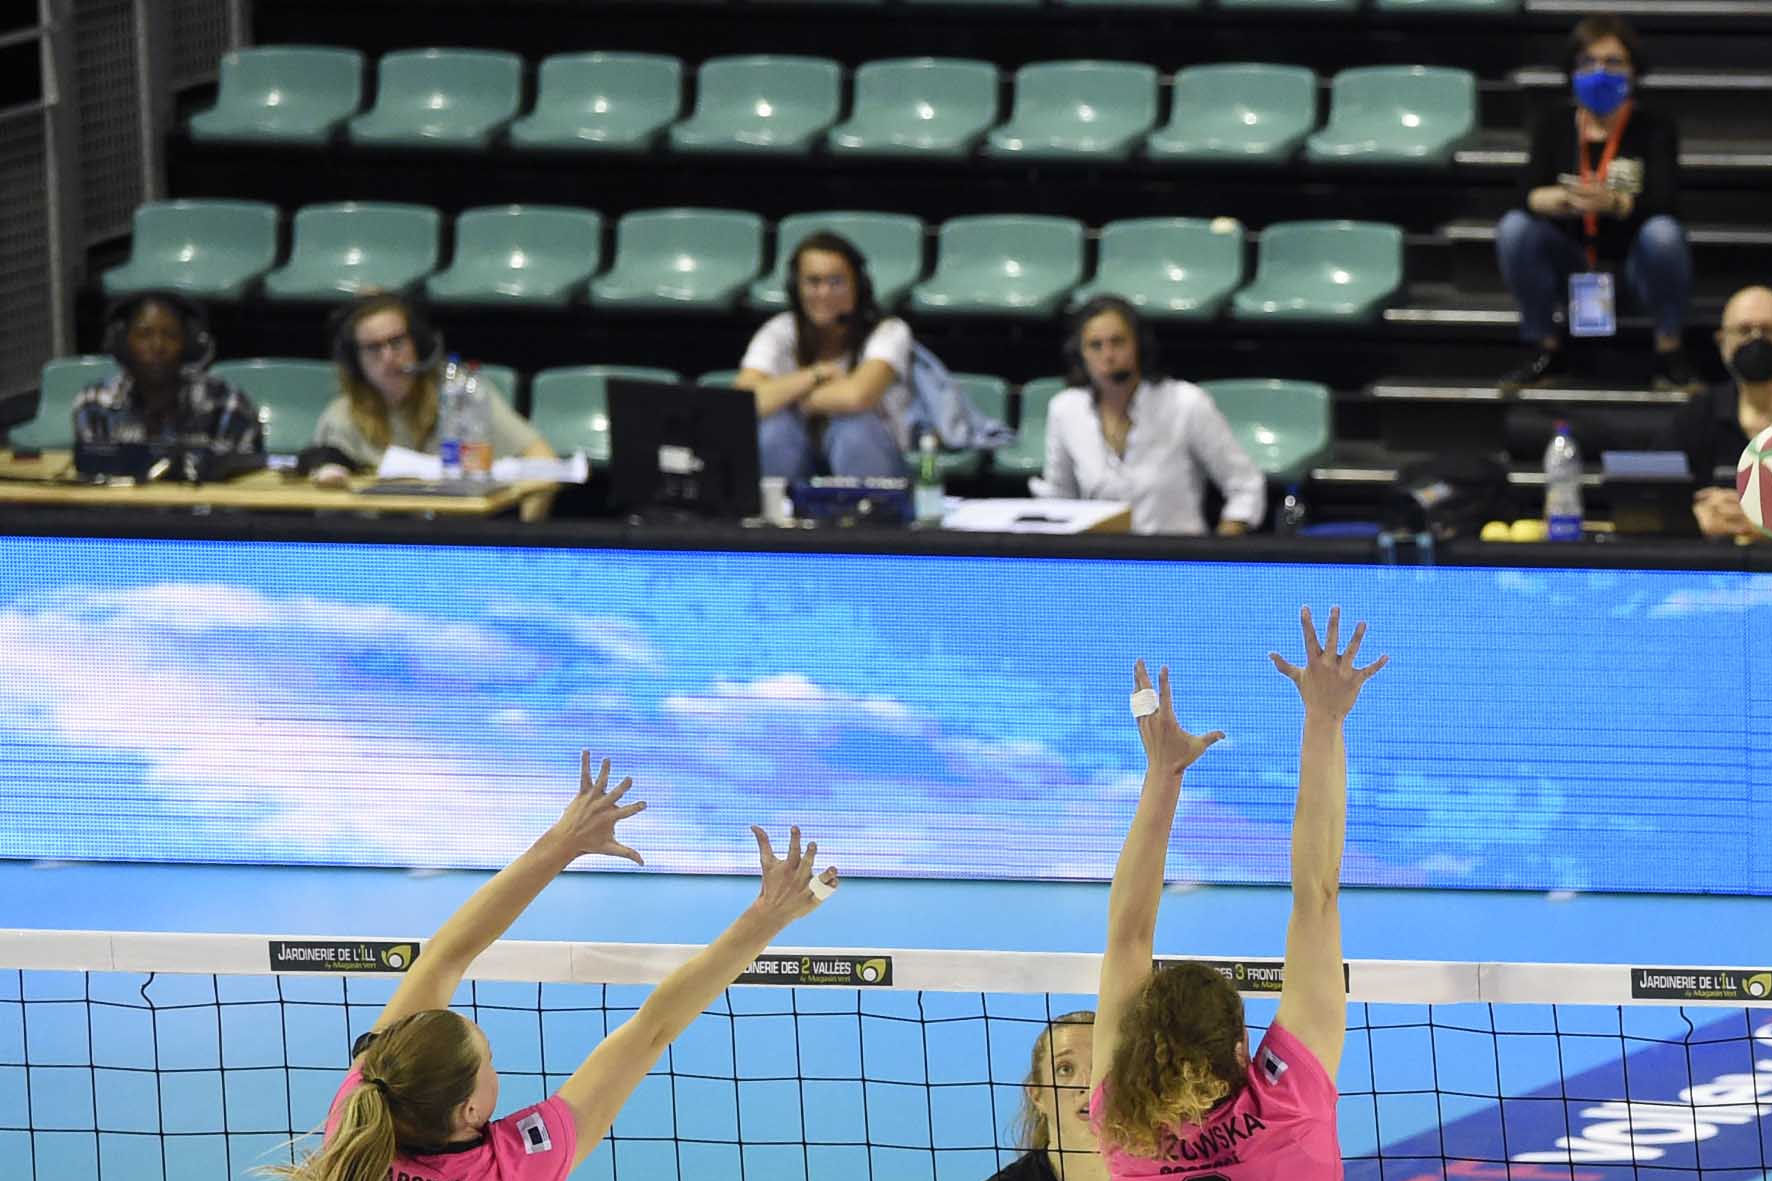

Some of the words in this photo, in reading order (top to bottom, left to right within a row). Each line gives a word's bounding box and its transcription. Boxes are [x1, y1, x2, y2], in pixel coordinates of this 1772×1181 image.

[278, 943, 335, 961] JARDINERIE
[338, 948, 351, 961] DE
[781, 961, 799, 974] DES
[802, 957, 810, 975] 2
[812, 959, 851, 975] VALLÉES
[1235, 963, 1245, 980] 3
[1639, 970, 1697, 989] JARDINERIE
[1699, 975, 1712, 989] DE
